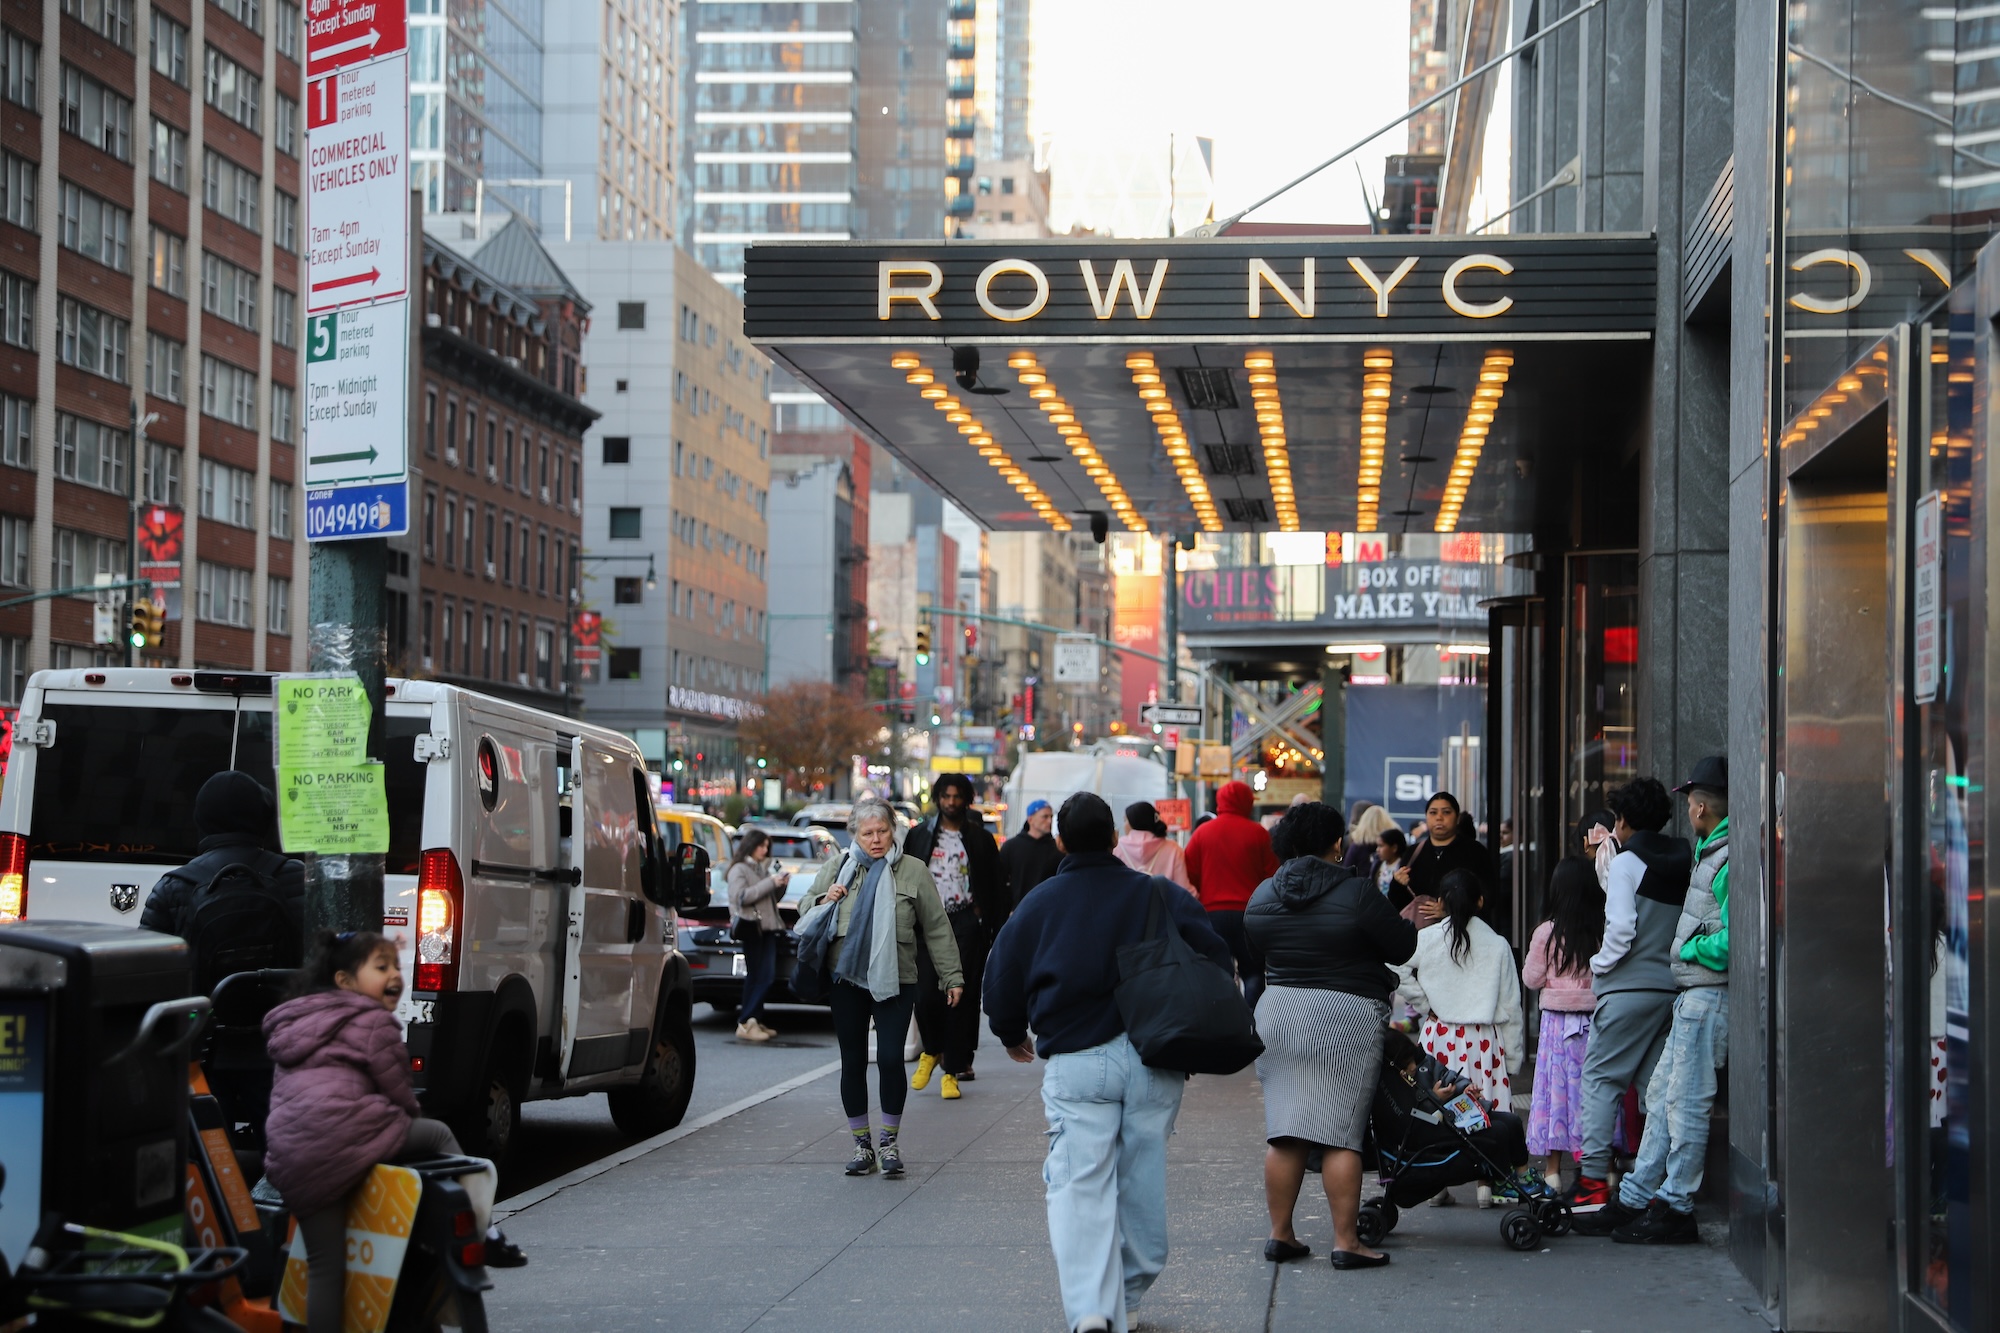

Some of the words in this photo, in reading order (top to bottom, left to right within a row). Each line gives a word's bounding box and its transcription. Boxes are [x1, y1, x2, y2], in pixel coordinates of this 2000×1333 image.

[310, 12, 341, 37] Except
[343, 3, 376, 27] Sunday
[341, 70, 360, 87] hour
[317, 78, 328, 122] 1
[341, 81, 376, 103] metered
[341, 102, 372, 124] parking
[312, 131, 387, 167] COMMERCIAL
[312, 163, 366, 194] VEHICLES
[369, 154, 399, 180] ONLY
[312, 226, 331, 244] 7am
[339, 220, 360, 240] 4pm
[312, 242, 344, 266] Except
[346, 238, 381, 258] Sunday
[877, 258, 1170, 322] ROW
[1248, 253, 1515, 319] NYC
[341, 311, 360, 325] hour
[313, 315, 331, 358] 5
[340, 323, 375, 341] metered
[340, 343, 370, 362] parking
[310, 382, 329, 400] 7pm
[338, 375, 377, 396] Midnight
[309, 403, 340, 423] Except
[343, 399, 378, 419] Sunday
[309, 490, 334, 500] Zone#
[309, 502, 368, 535] 104949
[1357, 566, 1398, 588] BOX
[1185, 570, 1284, 609] CHES
[1334, 592, 1414, 620] MAKE
[293, 687, 314, 699] NO
[318, 686, 354, 698] PARK
[293, 774, 313, 786] NO
[317, 772, 374, 785] PARKING
[323, 808, 349, 816] TUESDAY
[333, 823, 359, 831] NSFW
[344, 1236, 374, 1265] CO
